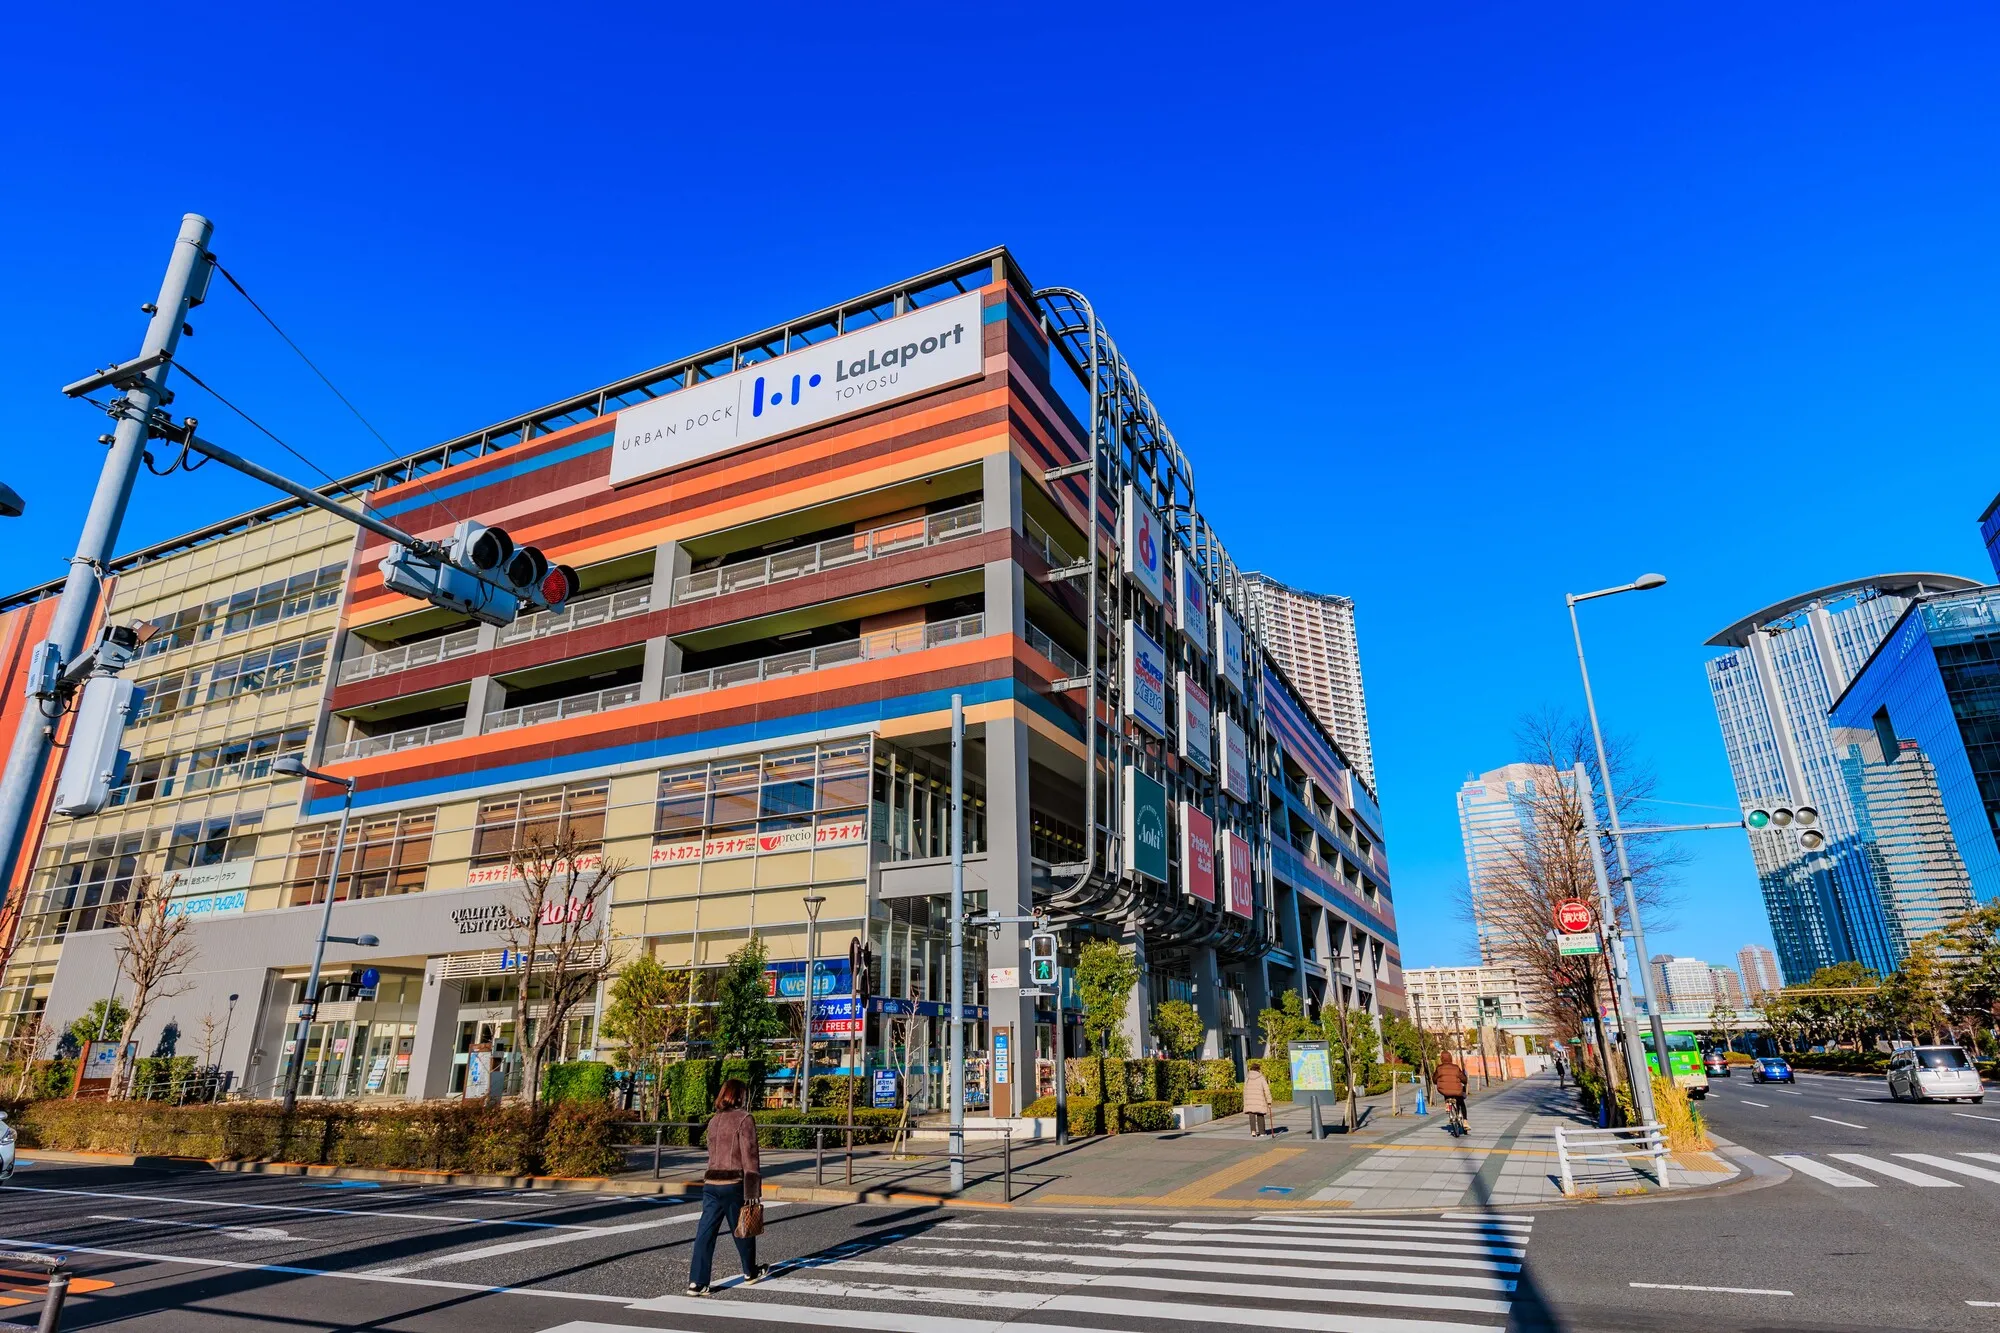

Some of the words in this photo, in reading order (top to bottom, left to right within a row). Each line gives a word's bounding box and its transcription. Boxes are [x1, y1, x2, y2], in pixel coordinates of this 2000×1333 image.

[836, 323, 964, 382] LaLaport
[836, 372, 899, 401] TOYOSU
[622, 424, 677, 450] URBAN
[685, 405, 733, 430] DOCK
[1716, 655, 1739, 672] IHI
[1135, 657, 1161, 693] SPORTS
[1134, 675, 1163, 714] XEBIO
[817, 824, 862, 841] カラオケ
[1138, 823, 1160, 850] Aoki
[652, 846, 701, 863] ネットカフェ
[705, 837, 745, 856] カラオケ
[1231, 844, 1248, 875] UNI
[469, 870, 501, 884] カラオケ
[1233, 876, 1250, 907] QLO
[185, 898, 213, 915] SPORTS
[450, 905, 497, 923] QUALITY
[496, 905, 506, 917] &
[458, 919, 491, 933] TASTY
[491, 915, 530, 931] FOODS
[1562, 911, 1588, 923] 消火栓
[786, 976, 829, 992] wecia
[811, 1022, 824, 1031] TAX
[826, 1021, 846, 1031] FREE
